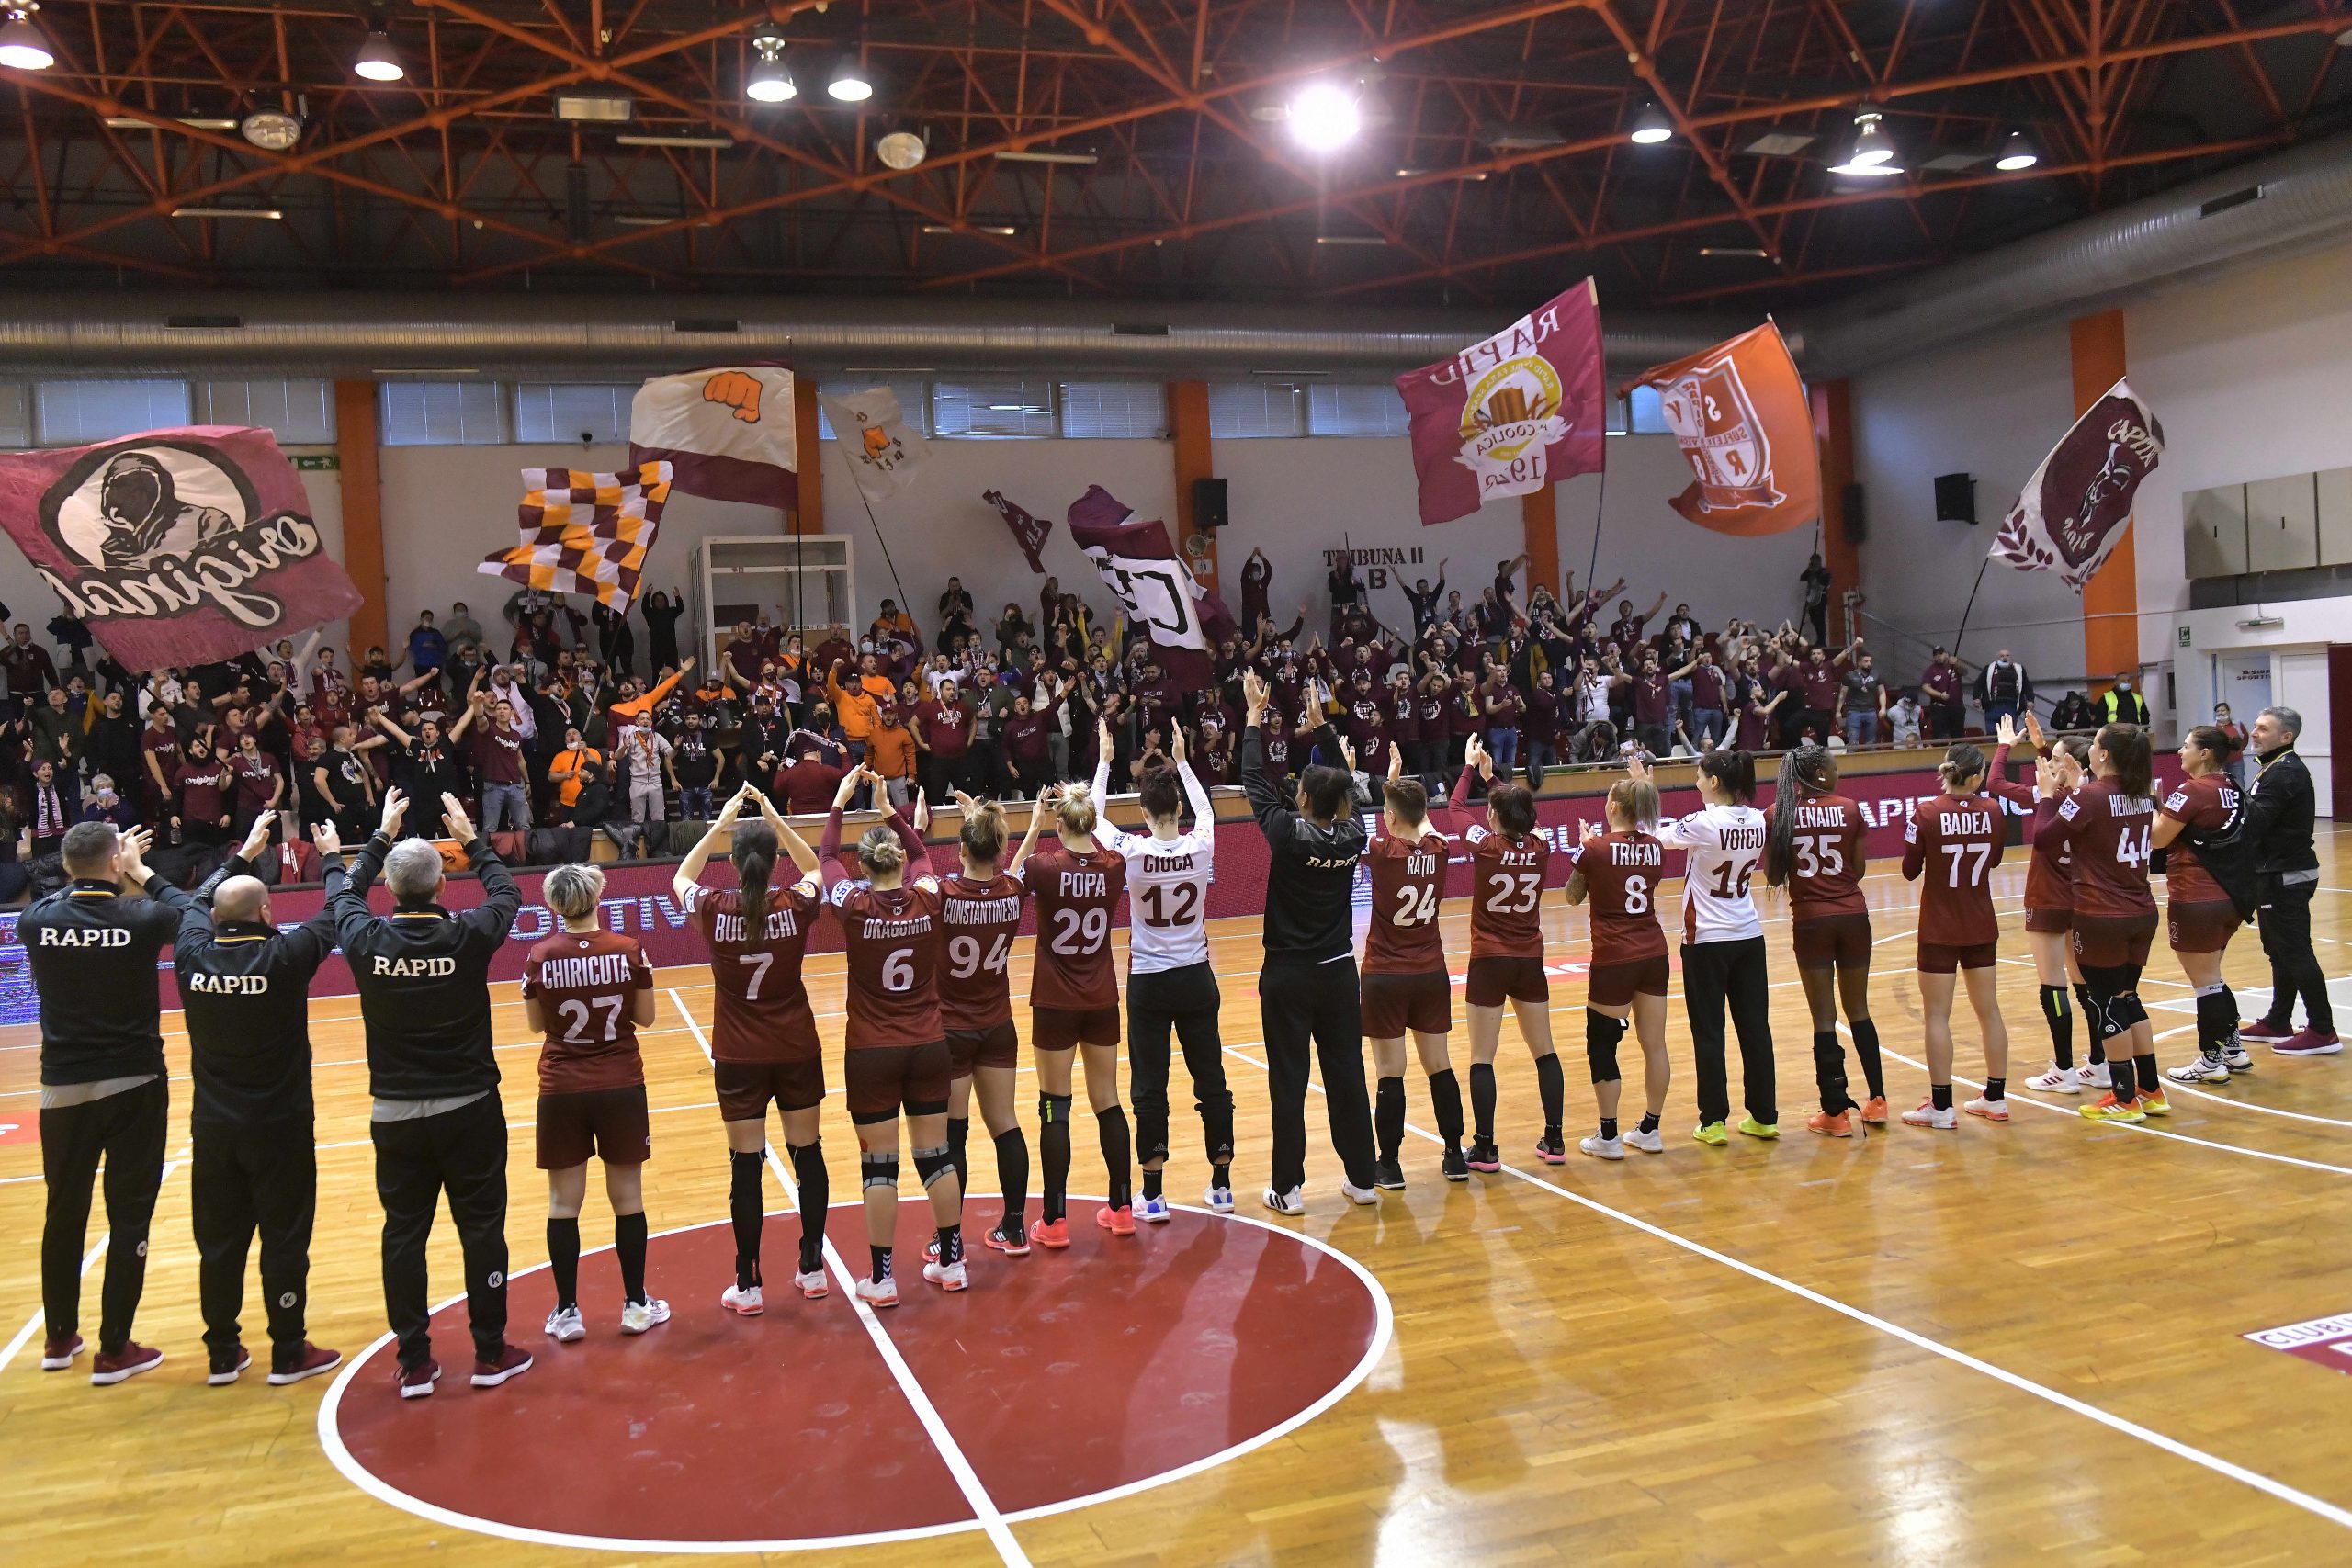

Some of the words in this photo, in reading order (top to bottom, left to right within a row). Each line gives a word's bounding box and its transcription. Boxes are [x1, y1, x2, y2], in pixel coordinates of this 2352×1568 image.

[2061, 517, 2096, 553] 2018
[1323, 547, 1408, 567] TIBUNA
[1368, 568, 1388, 590] B
[185, 773, 220, 785] Original
[1857, 795, 1939, 828] API
[1939, 811, 1993, 836] BADEA
[1609, 841, 1661, 867] TRIFAN
[1719, 826, 1765, 851] VOICU
[1499, 850, 1537, 867] ILIE
[1792, 834, 1845, 879] 35
[1940, 841, 1992, 889] 77
[1059, 871, 1107, 898] POPA
[1486, 873, 1542, 914] 23
[1624, 874, 1648, 915] 8
[1709, 859, 1758, 899] 16
[1140, 881, 1199, 928] 12
[1392, 883, 1437, 928] 24
[39, 926, 132, 948] RAPID
[714, 908, 797, 942] BUCCHI
[862, 913, 933, 940] DRAGOMIR
[1050, 907, 1108, 955] 29
[372, 954, 457, 977] RAPID
[541, 953, 632, 990] CHIRICUTA
[881, 947, 915, 992] 6
[948, 932, 1010, 979] 94
[189, 972, 269, 995] RAPID
[739, 952, 774, 1001] 7
[557, 993, 625, 1045] 27
